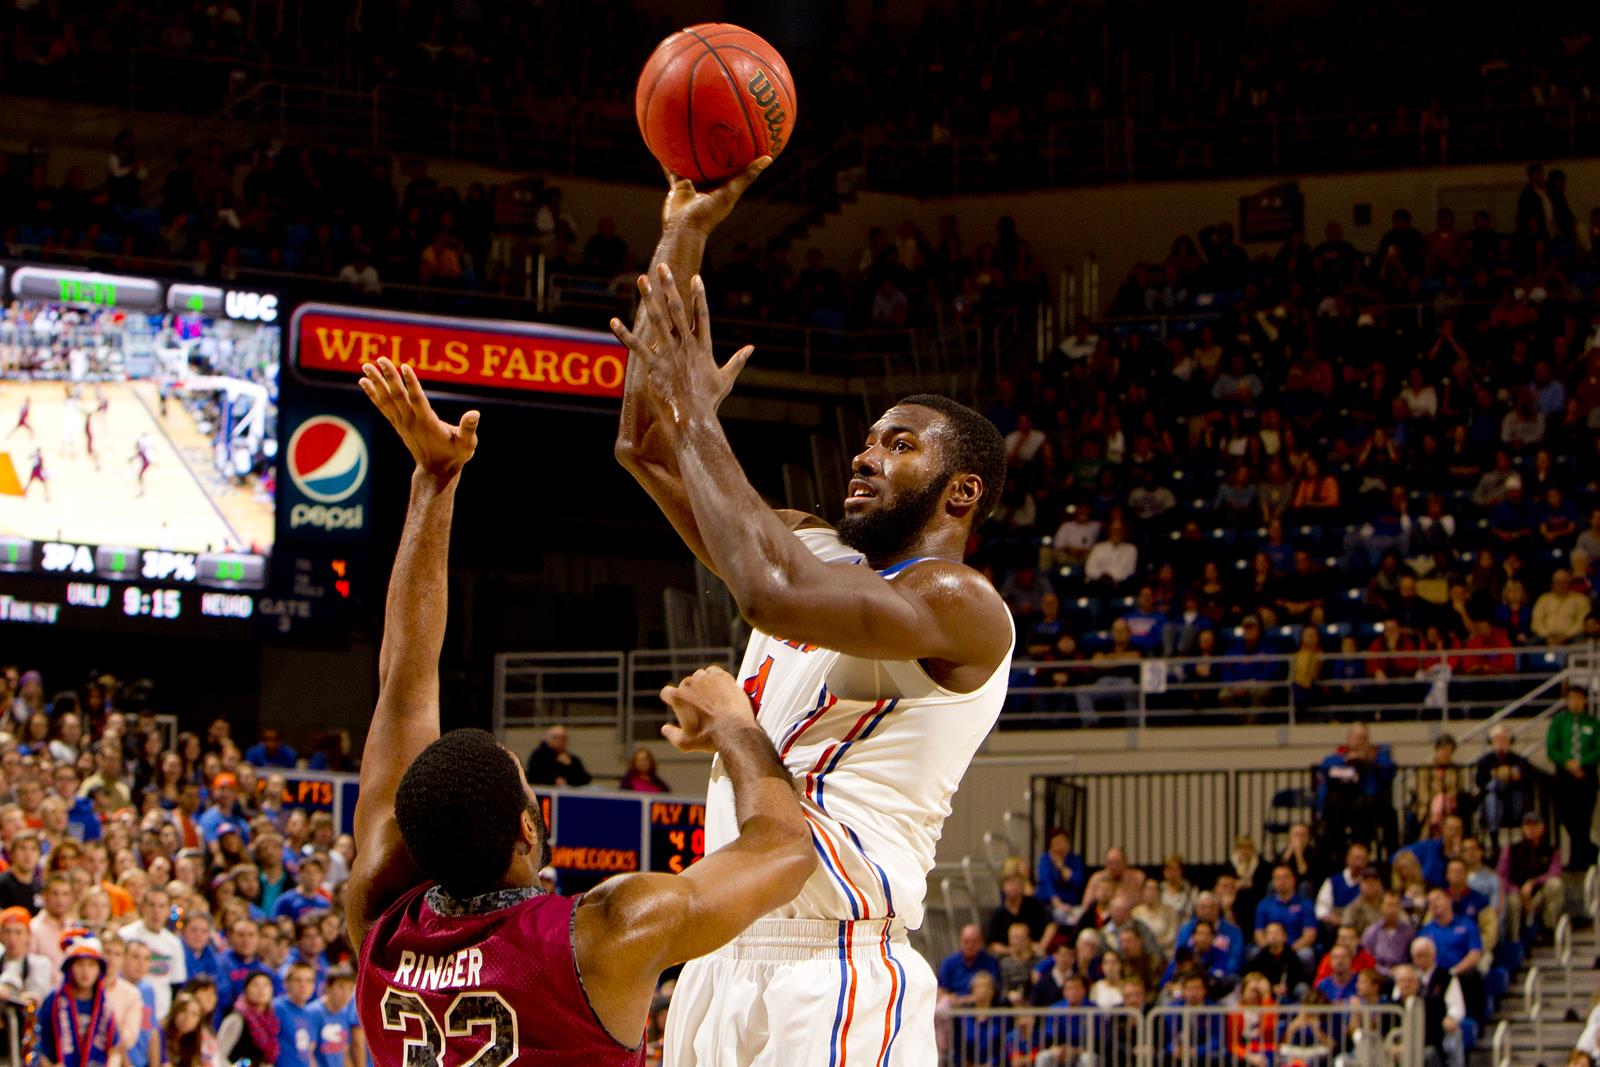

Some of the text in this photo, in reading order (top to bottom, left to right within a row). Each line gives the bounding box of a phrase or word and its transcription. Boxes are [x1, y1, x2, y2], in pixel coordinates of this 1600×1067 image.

[315, 327, 625, 389] WELLS FARGO
[290, 504, 363, 531] pepsi
[258, 597, 312, 619] GATE
[298, 781, 333, 805] PTS
[394, 948, 484, 991] RINGER
[380, 985, 520, 1067] 32
